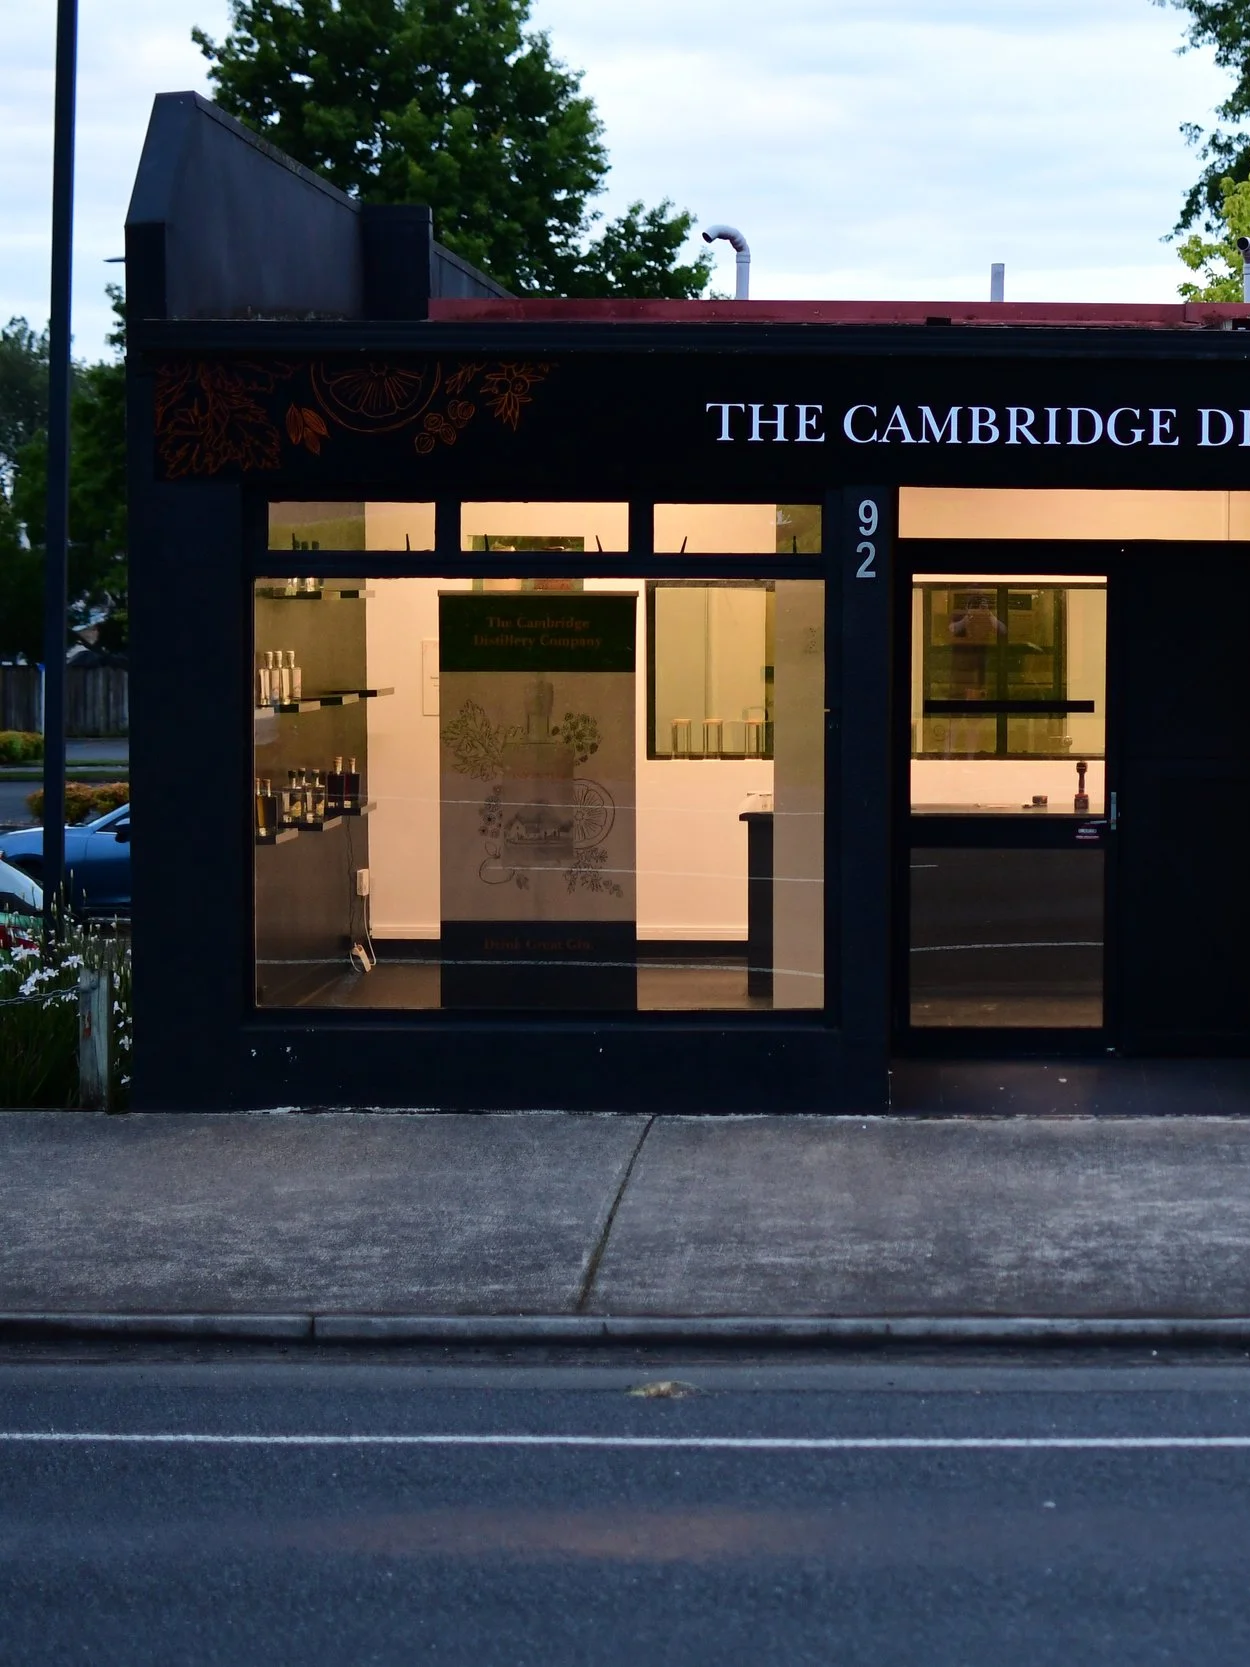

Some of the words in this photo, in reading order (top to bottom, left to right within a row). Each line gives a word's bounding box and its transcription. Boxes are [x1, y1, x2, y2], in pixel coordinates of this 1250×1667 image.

[705, 402, 826, 442] THE
[843, 404, 1180, 447] CAMBRIDGE
[486, 616, 511, 629] The
[516, 615, 591, 632] Cambridge
[473, 633, 536, 650] Distillery
[539, 633, 603, 650] Company
